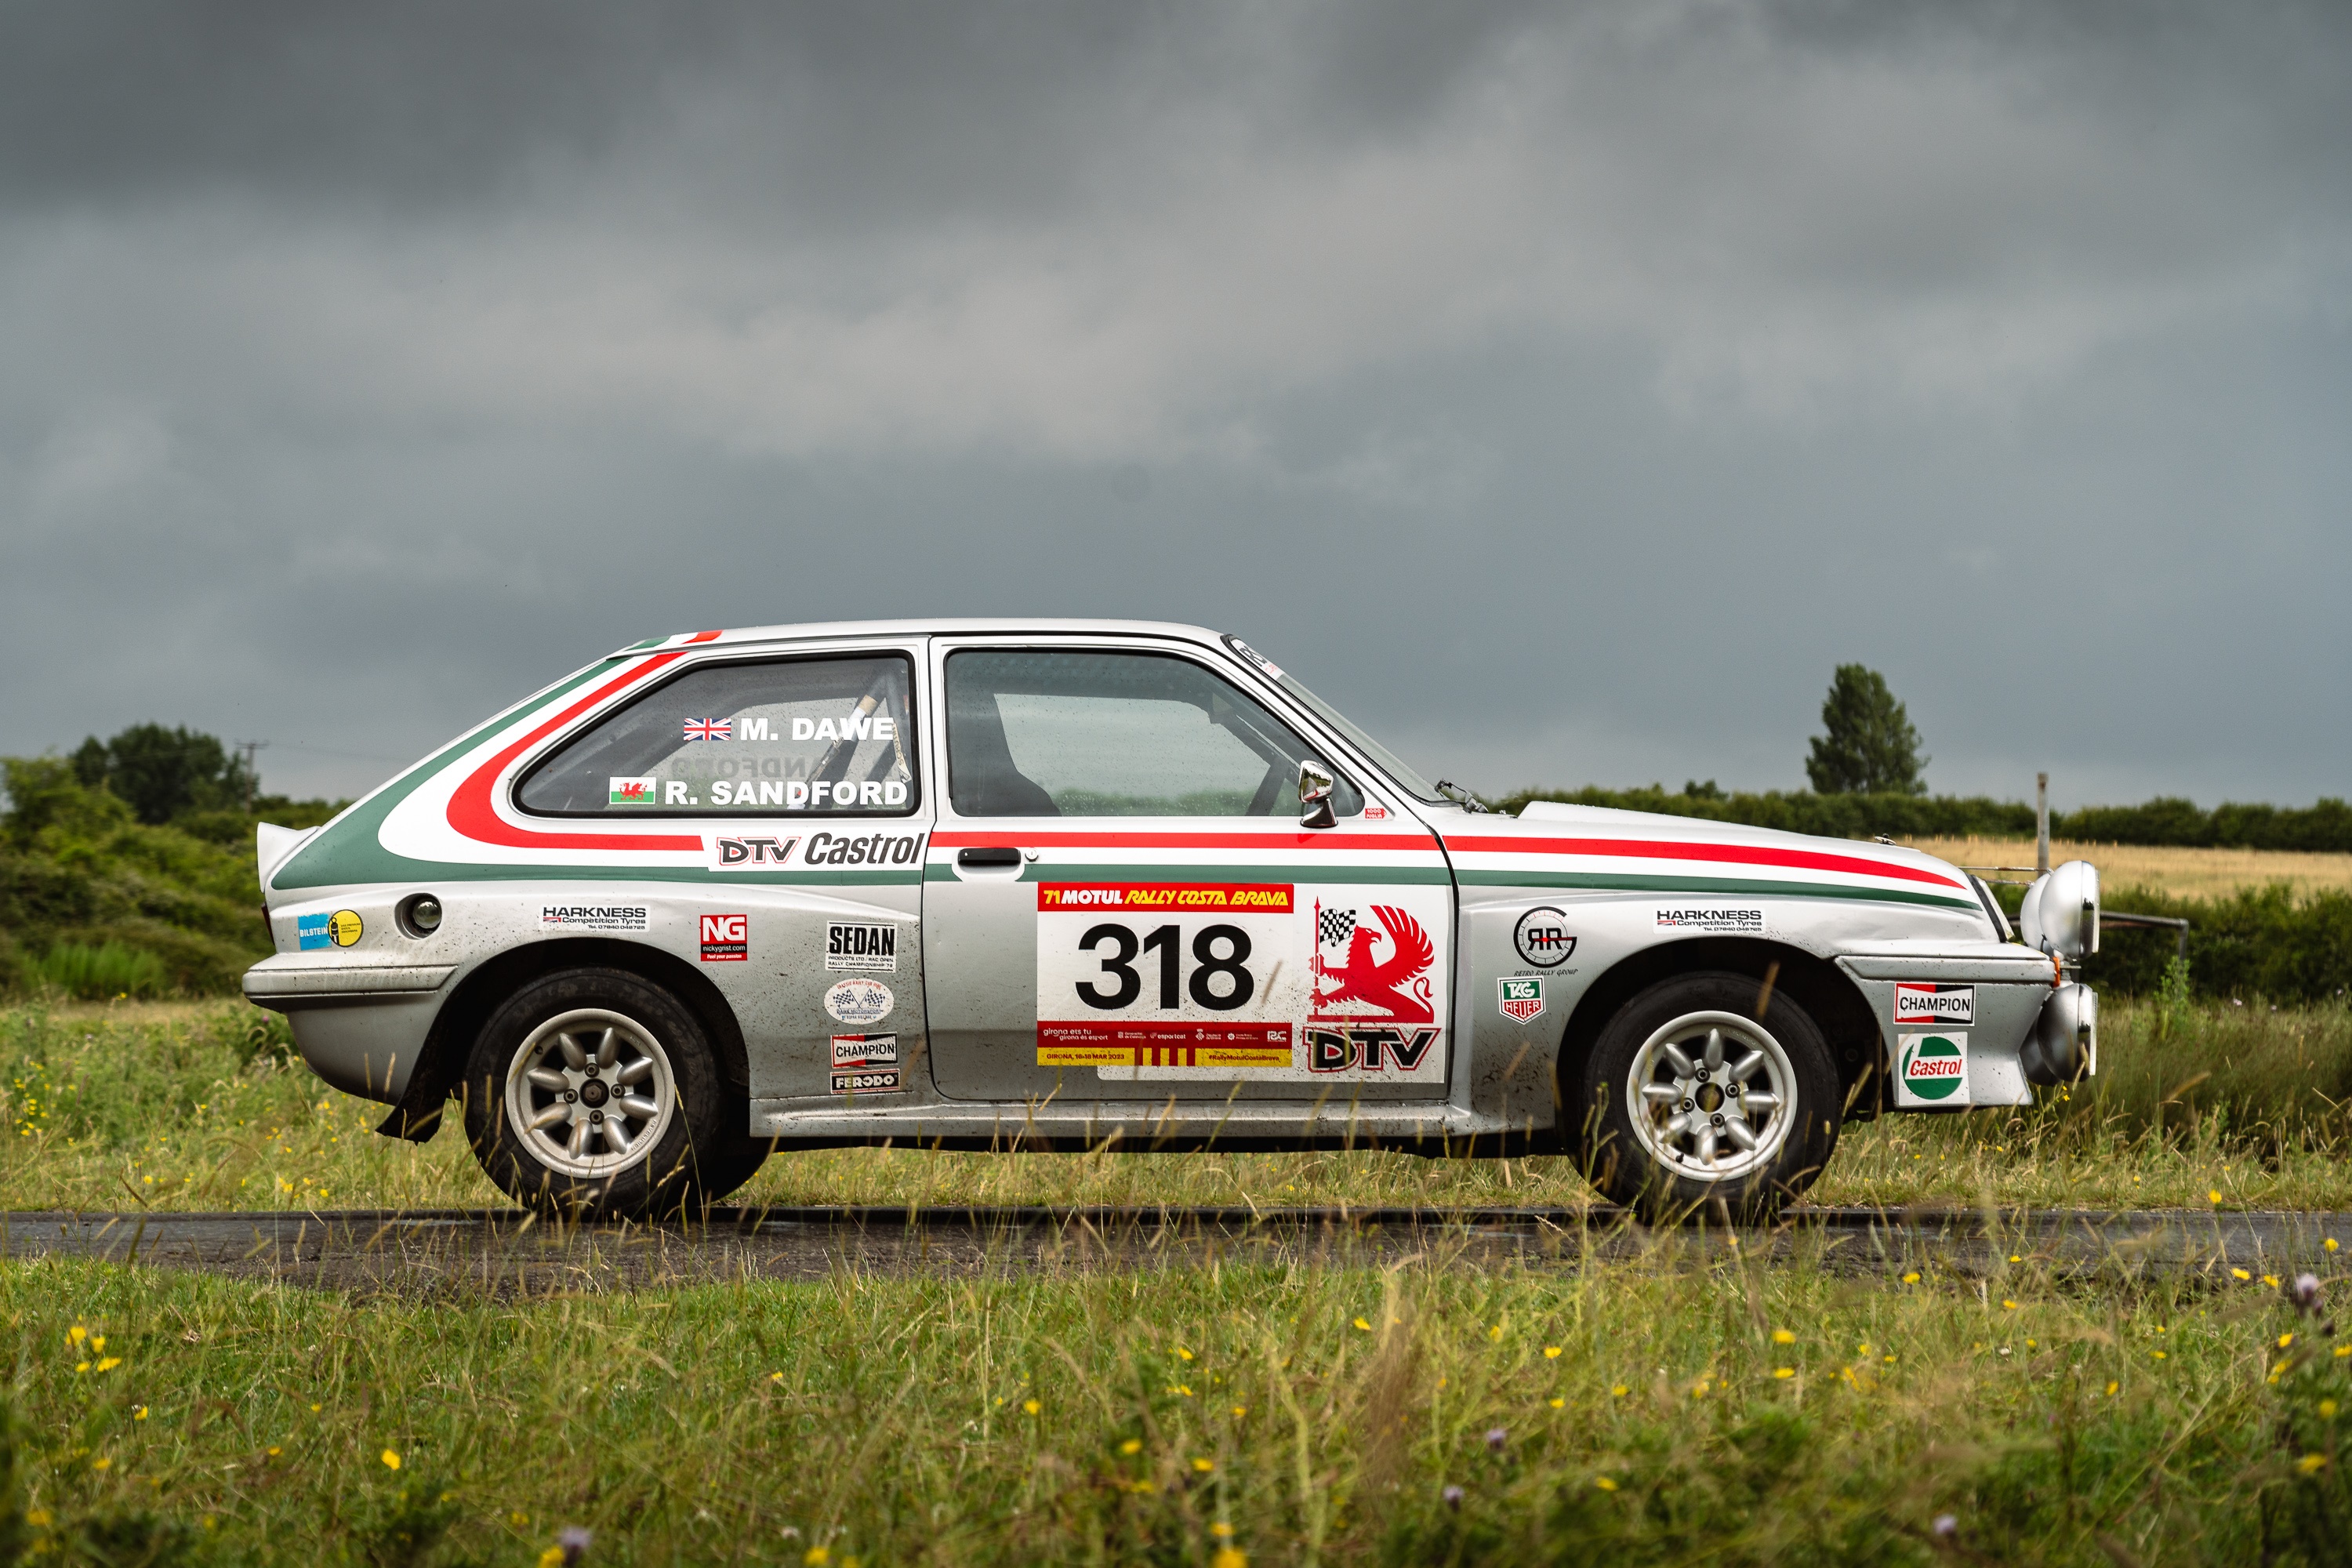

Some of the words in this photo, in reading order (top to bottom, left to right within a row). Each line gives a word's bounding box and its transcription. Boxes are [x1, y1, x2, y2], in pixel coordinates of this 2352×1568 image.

[740, 717, 779, 741] M.
[792, 717, 894, 741] DAWE
[665, 781, 699, 805] R.
[710, 781, 908, 805] SANDFORD
[717, 837, 801, 866] DTV
[804, 832, 925, 865] Castrol
[1044, 890, 1061, 904] 71
[1061, 890, 1123, 905] MOTUL
[1124, 890, 1177, 905] RALLY
[1177, 890, 1228, 906] COSTA
[1229, 891, 1289, 906] BRAVA
[543, 906, 647, 918] HARKNESS
[1657, 910, 1762, 920] HARKNESS
[299, 927, 328, 938] BILSTEIN
[702, 916, 746, 942] NG
[702, 945, 746, 953] nickygrist.com
[829, 926, 895, 956] SEDAN
[1075, 924, 1255, 1011] 318
[1507, 981, 1536, 998] TAG
[1505, 1000, 1541, 1019] HEUER
[1900, 996, 1971, 1011] CHAMPION
[1043, 1027, 1069, 1037] girona
[836, 1044, 895, 1058] CHAMPION
[1302, 1026, 1442, 1073] DTV
[1910, 1058, 1963, 1076] Castrol
[836, 1074, 895, 1089] FERODO
